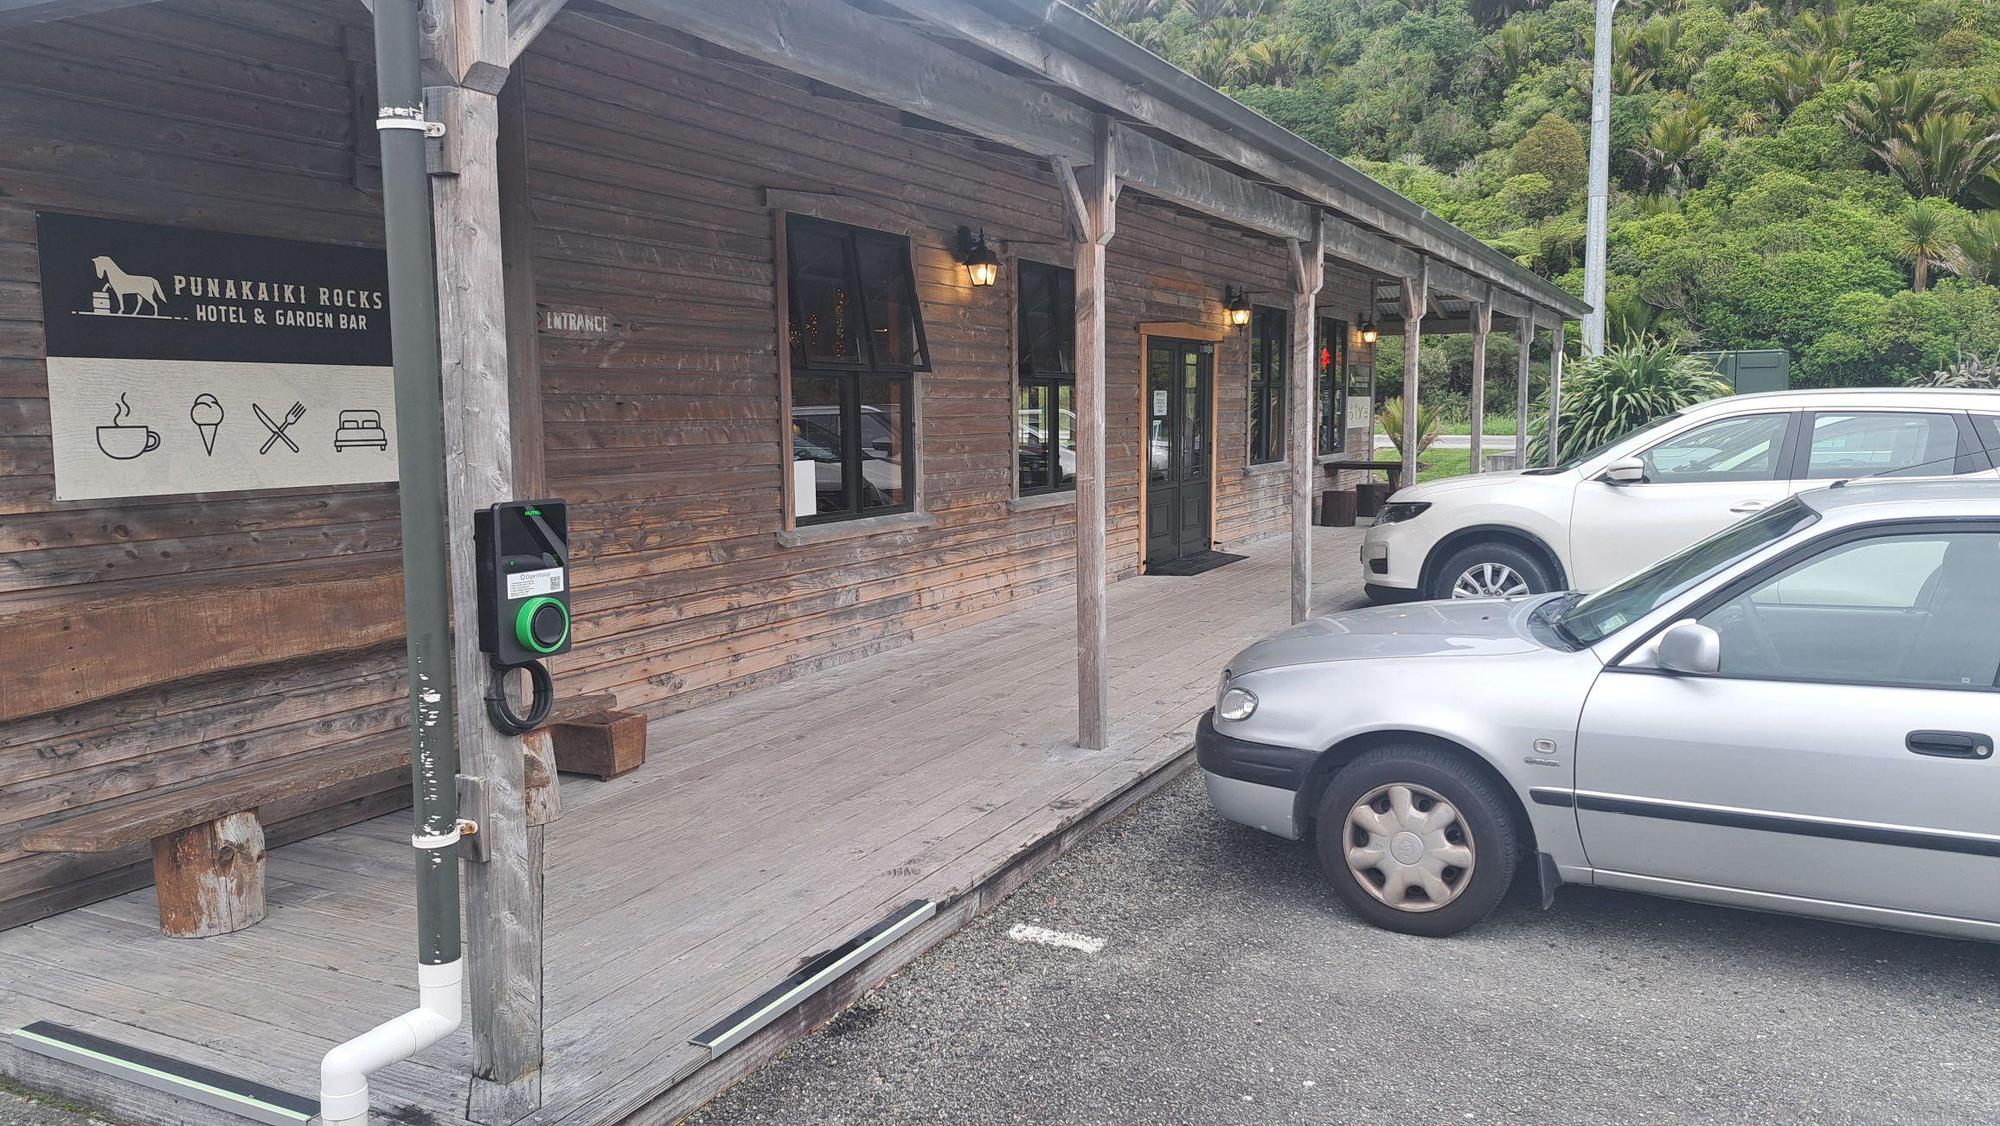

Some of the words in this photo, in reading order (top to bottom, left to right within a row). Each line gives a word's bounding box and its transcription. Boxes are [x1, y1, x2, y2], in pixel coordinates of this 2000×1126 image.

[173, 275, 306, 304] PUNAKAIKI
[319, 287, 383, 310] ROCKS
[196, 304, 247, 324] HOTEL
[254, 308, 267, 325] &
[275, 309, 334, 329] GARDEN
[339, 313, 367, 330] BAR
[547, 312, 608, 332] ENTRANCE
